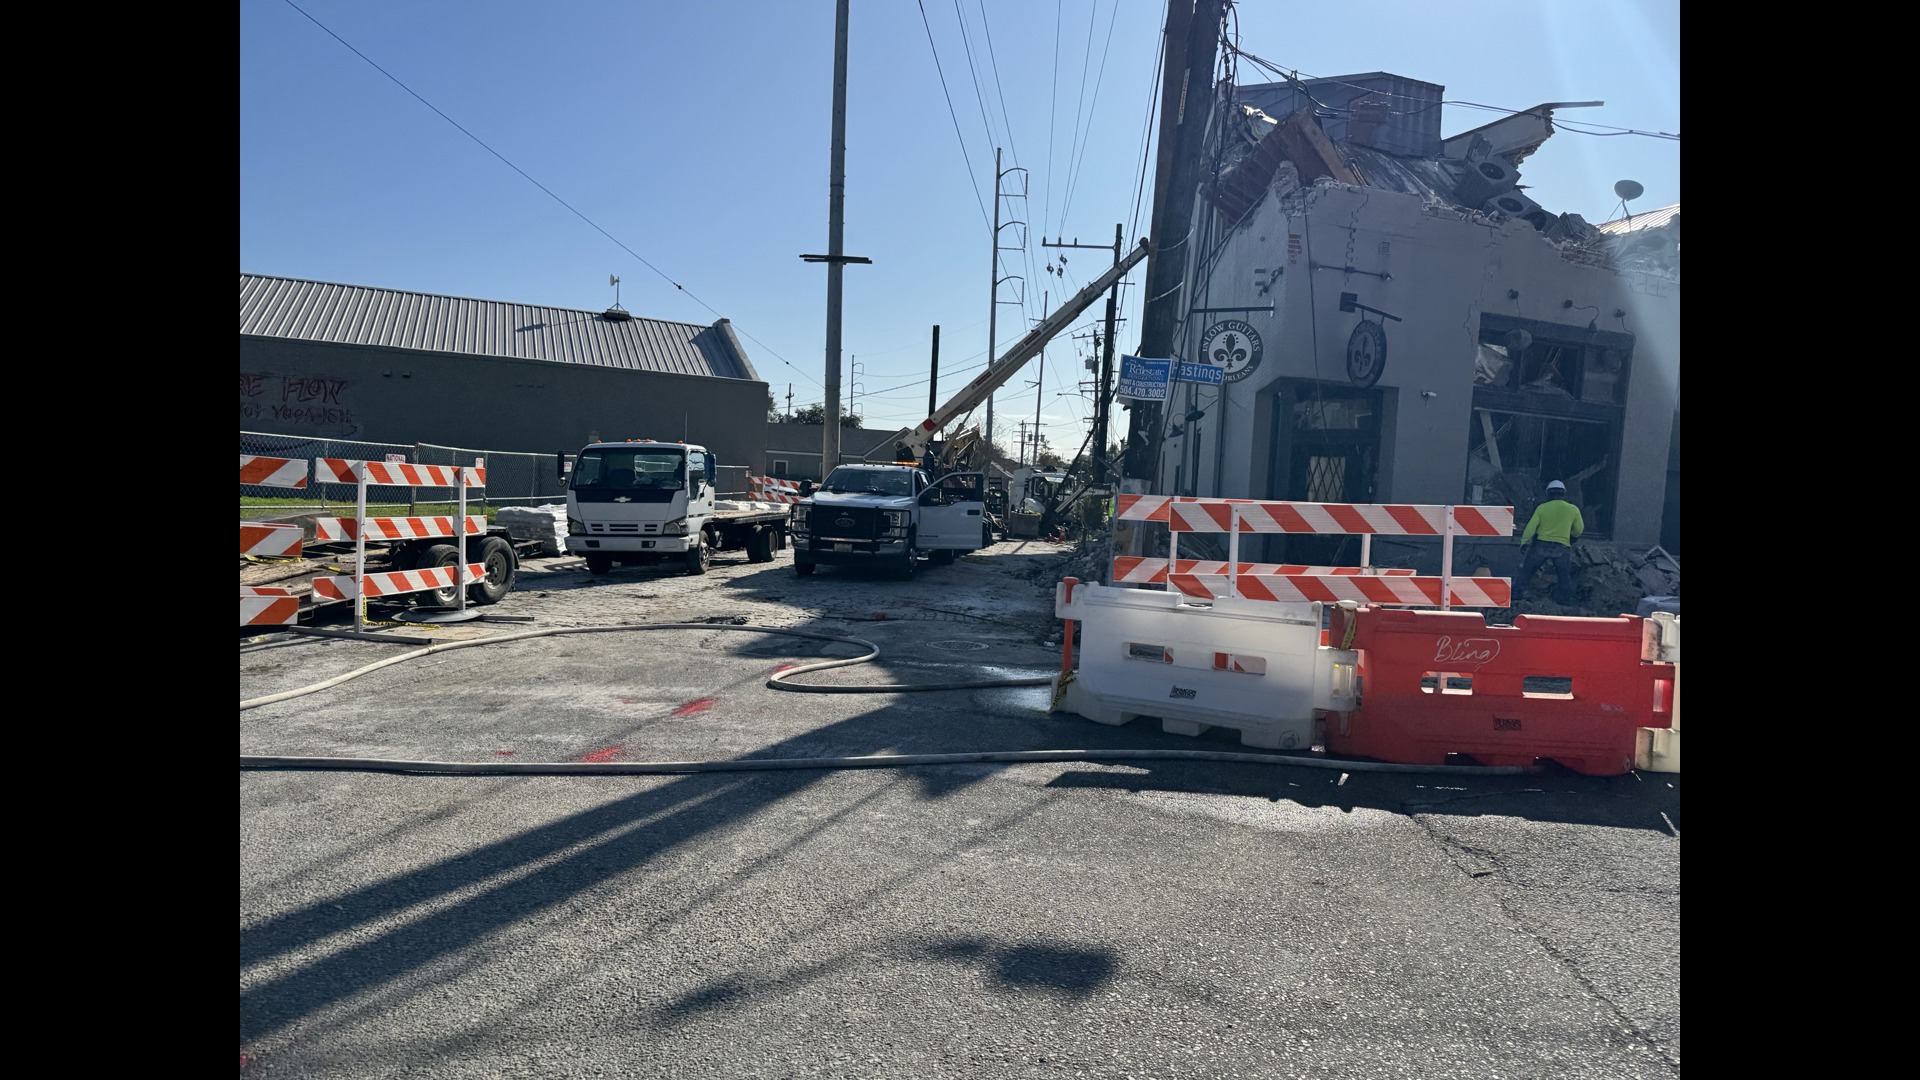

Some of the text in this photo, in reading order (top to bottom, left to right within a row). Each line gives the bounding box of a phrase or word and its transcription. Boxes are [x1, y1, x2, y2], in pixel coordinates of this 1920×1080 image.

[1202, 321, 1261, 352] INLOW GUITARS
[1172, 362, 1222, 383] Hastings
[1119, 385, 1165, 398] 504.470.3002
